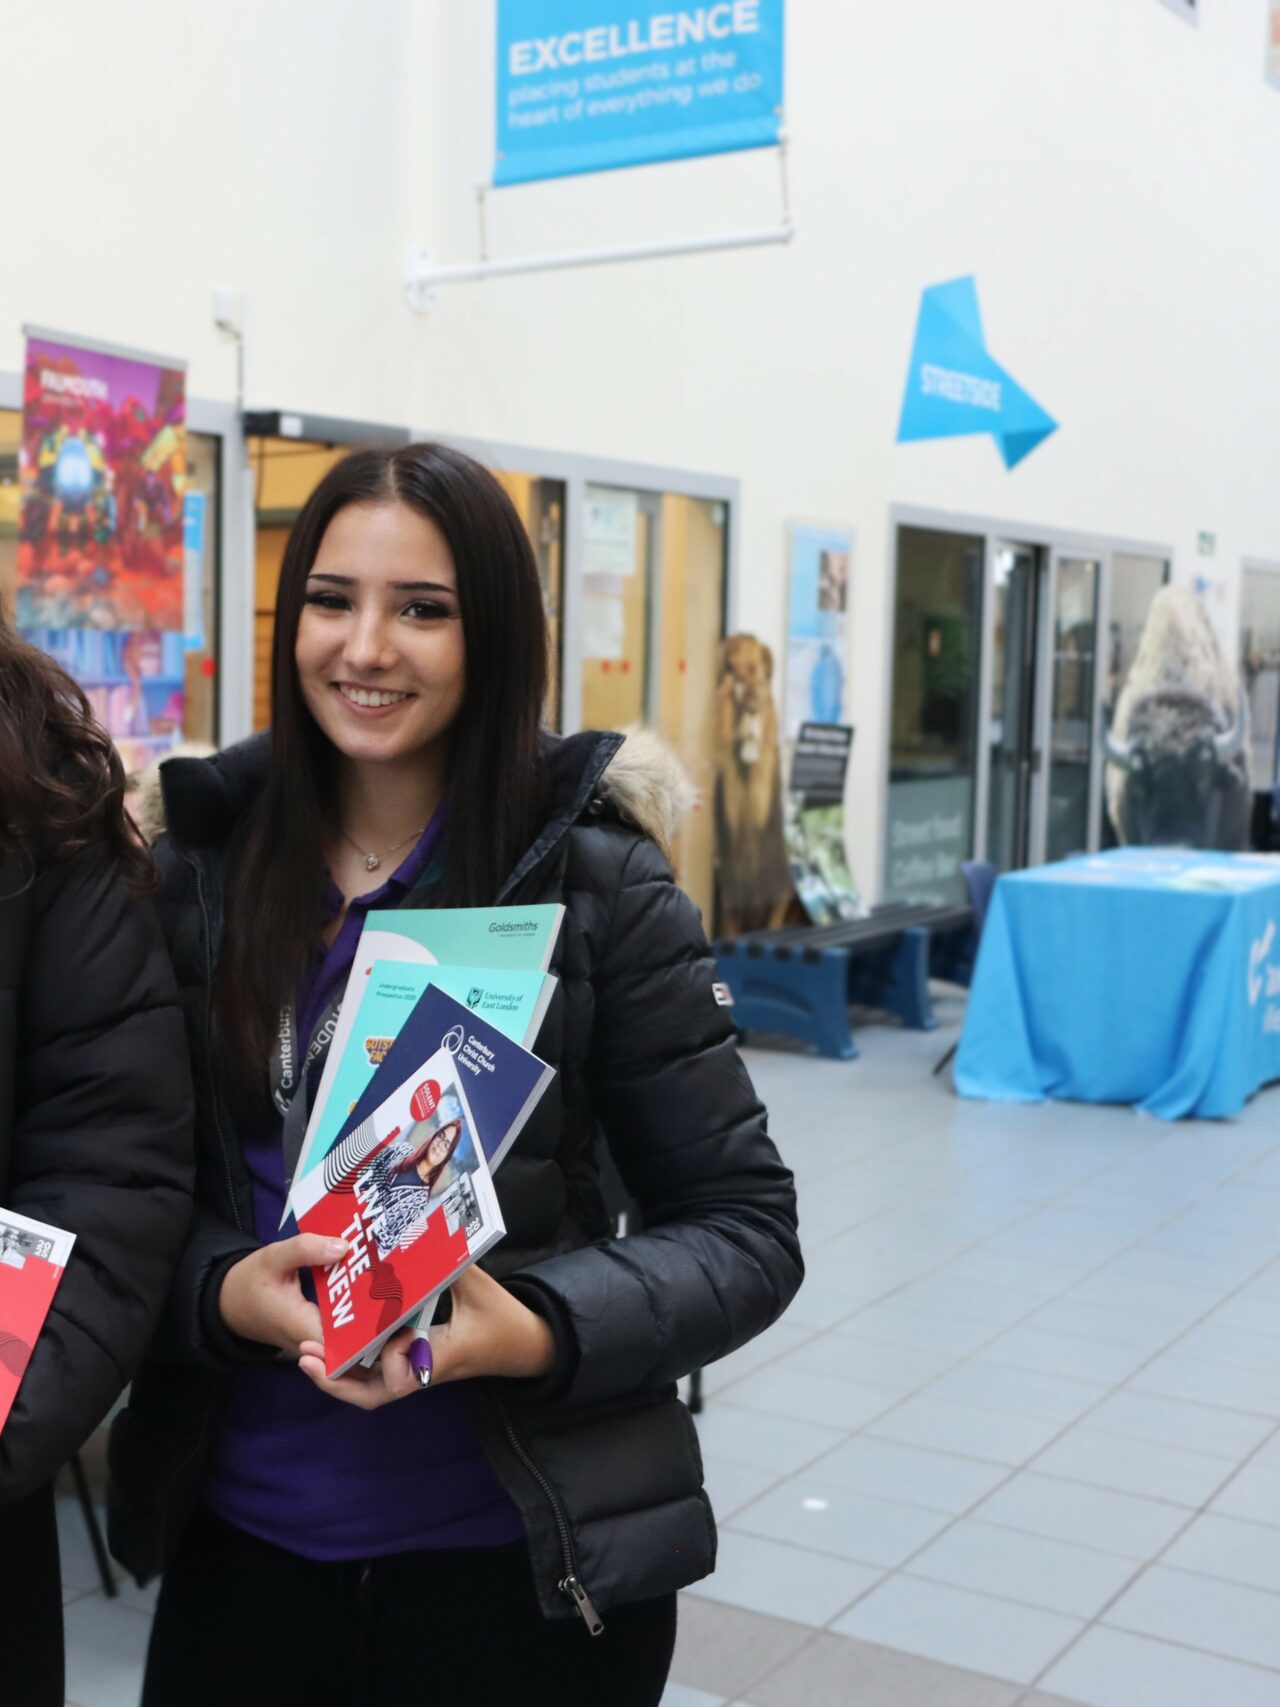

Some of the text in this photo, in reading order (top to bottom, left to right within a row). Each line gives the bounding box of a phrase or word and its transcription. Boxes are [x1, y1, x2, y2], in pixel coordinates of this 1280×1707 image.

[509, 1, 760, 75] EXCELLENCE
[508, 51, 736, 107] placing students at the
[508, 72, 761, 128] heart of everything we do
[489, 921, 538, 933] Goldsmiths
[481, 1001, 519, 1011] East London
[485, 992, 516, 1002] University
[463, 1044, 495, 1072] Christ Church
[468, 1035, 495, 1060] Canterbury
[458, 1052, 481, 1076] University
[353, 1171, 387, 1242] LIVE
[36, 1240, 52, 1251] 20
[341, 1212, 370, 1283] THE
[324, 1262, 355, 1329] NEW
